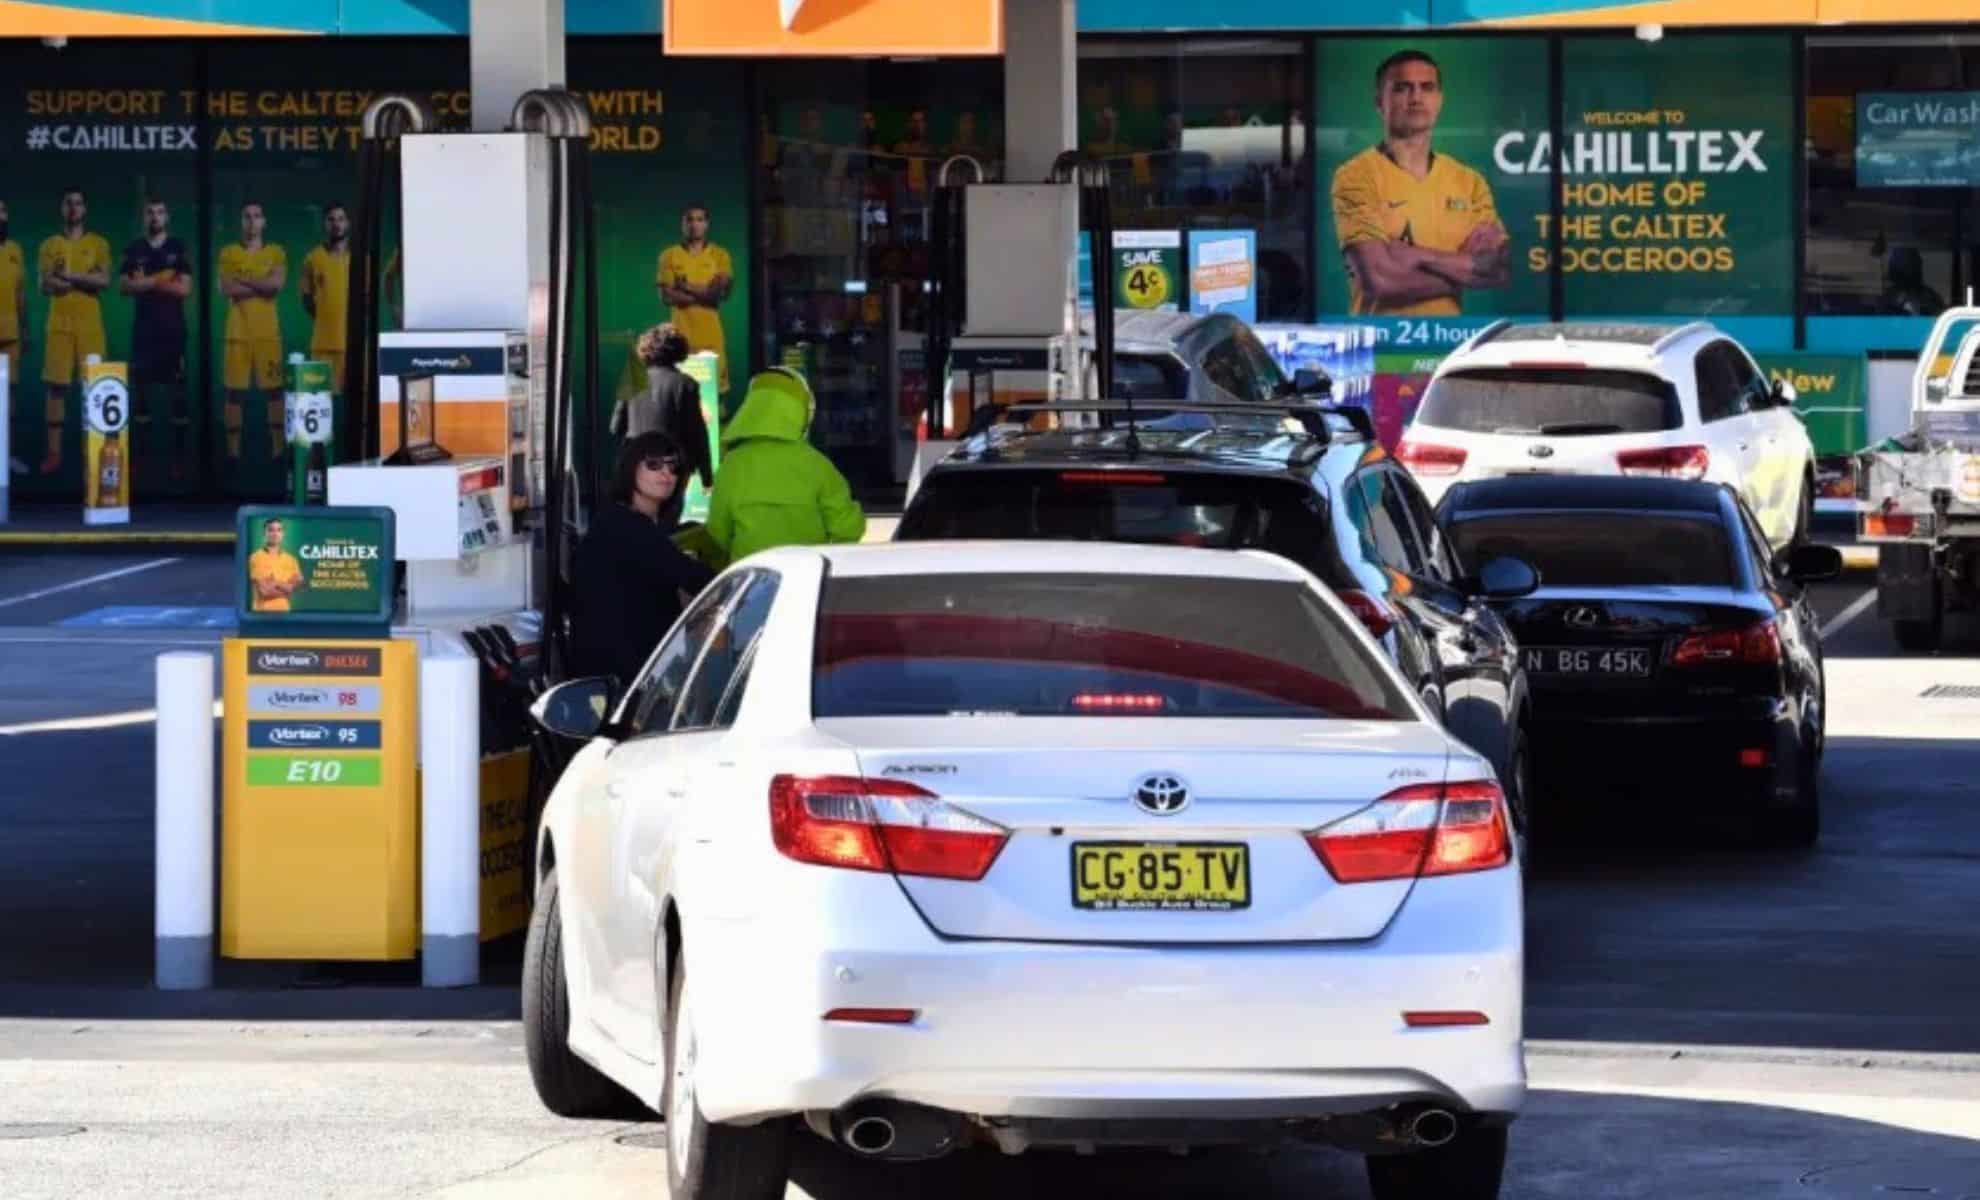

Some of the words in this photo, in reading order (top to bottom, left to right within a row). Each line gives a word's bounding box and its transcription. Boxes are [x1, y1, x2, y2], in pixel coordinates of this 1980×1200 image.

[27, 90, 165, 115] SUPPORT
[257, 91, 372, 116] CALTEX
[587, 91, 664, 114] WITH
[1866, 102, 1909, 124] Car
[1583, 111, 1659, 125] WELCOME
[1663, 110, 1685, 125] TO
[26, 125, 198, 150] #CAHILLTEX
[214, 127, 255, 150] AS
[260, 127, 341, 150] THEY
[586, 125, 661, 150] ORLD
[1493, 130, 1768, 174] CAHILLTEX
[1562, 182, 1656, 207] HOME
[1663, 181, 1707, 206] OF
[1610, 214, 1727, 240] CALTEX
[1122, 249, 1163, 268] SAVE
[1528, 246, 1735, 271] SOCCEROOS
[1395, 320, 1430, 344] 24
[1770, 367, 1836, 393] New
[299, 544, 379, 559] CAHILLTEX
[260, 652, 316, 668] Vortex
[270, 689, 325, 705] Vortex
[337, 692, 358, 706] 98
[272, 726, 326, 743] Vortex
[338, 727, 359, 743] 95
[286, 760, 342, 782] E10
